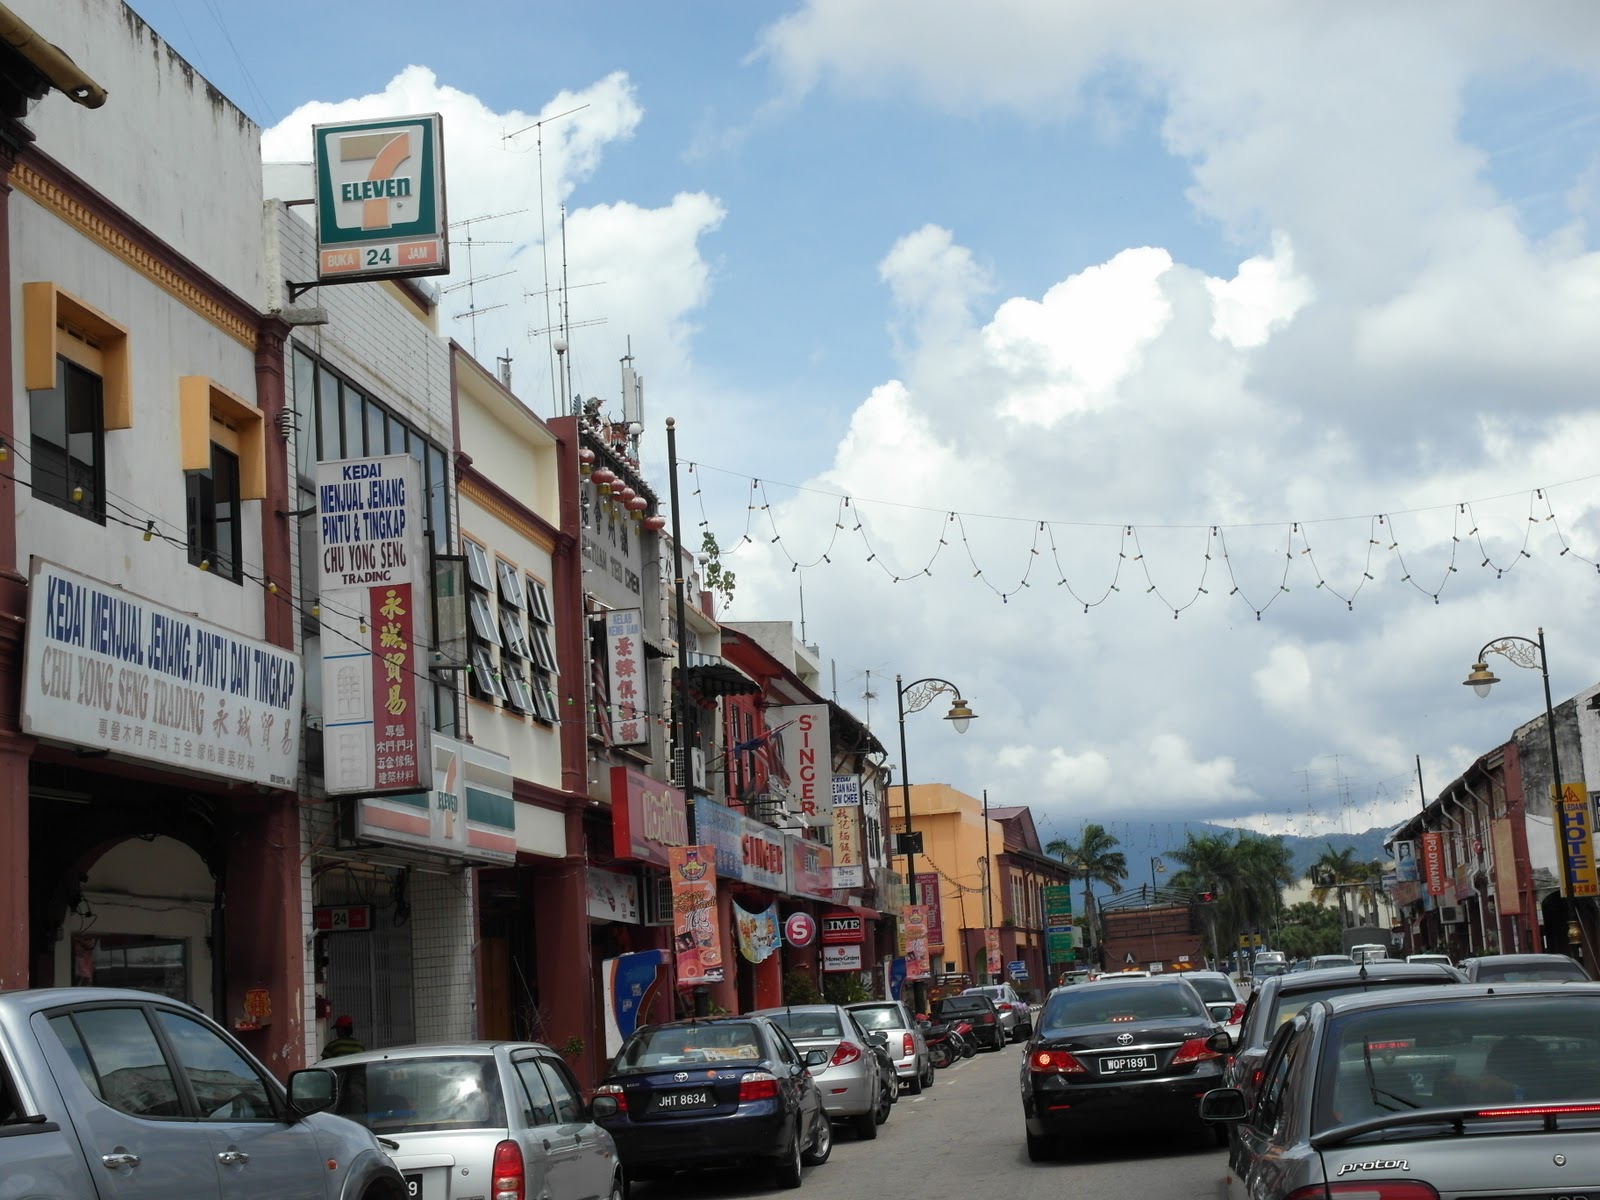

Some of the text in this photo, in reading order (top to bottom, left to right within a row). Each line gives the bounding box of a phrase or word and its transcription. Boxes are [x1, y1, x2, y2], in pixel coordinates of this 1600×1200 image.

[327, 246, 428, 267] BUKA 24 JAM
[343, 462, 382, 481] KEDAI
[320, 477, 405, 514] MENJUAL JENANG
[322, 509, 406, 545] PINTU & TINGKAP
[324, 546, 345, 574] CHU
[349, 543, 376, 571] YONG
[45, 575, 87, 648] KEDAI
[90, 590, 144, 666] MENJUAL
[195, 629, 228, 692] PINTU
[230, 641, 250, 698] DAN
[254, 649, 295, 711] TINGKAP
[40, 645, 205, 736] CHU YONG SENG TRADING
[798, 714, 816, 817] SINGER
[831, 776, 851, 784] KEDAI
[843, 793, 858, 804] CHEE
[1564, 802, 1588, 812] LEDANG
[741, 833, 783, 876] SINGER
[1427, 839, 1437, 852] PC
[1563, 812, 1590, 883] HOTEL
[1428, 853, 1441, 893] DYNAMIC
[333, 912, 347, 925] 24
[828, 919, 860, 931] IME
[791, 921, 808, 940] S
[1107, 1057, 1147, 1070] WQP1891
[658, 1093, 706, 1107] JHT 8634
[1337, 1158, 1410, 1176] proton
